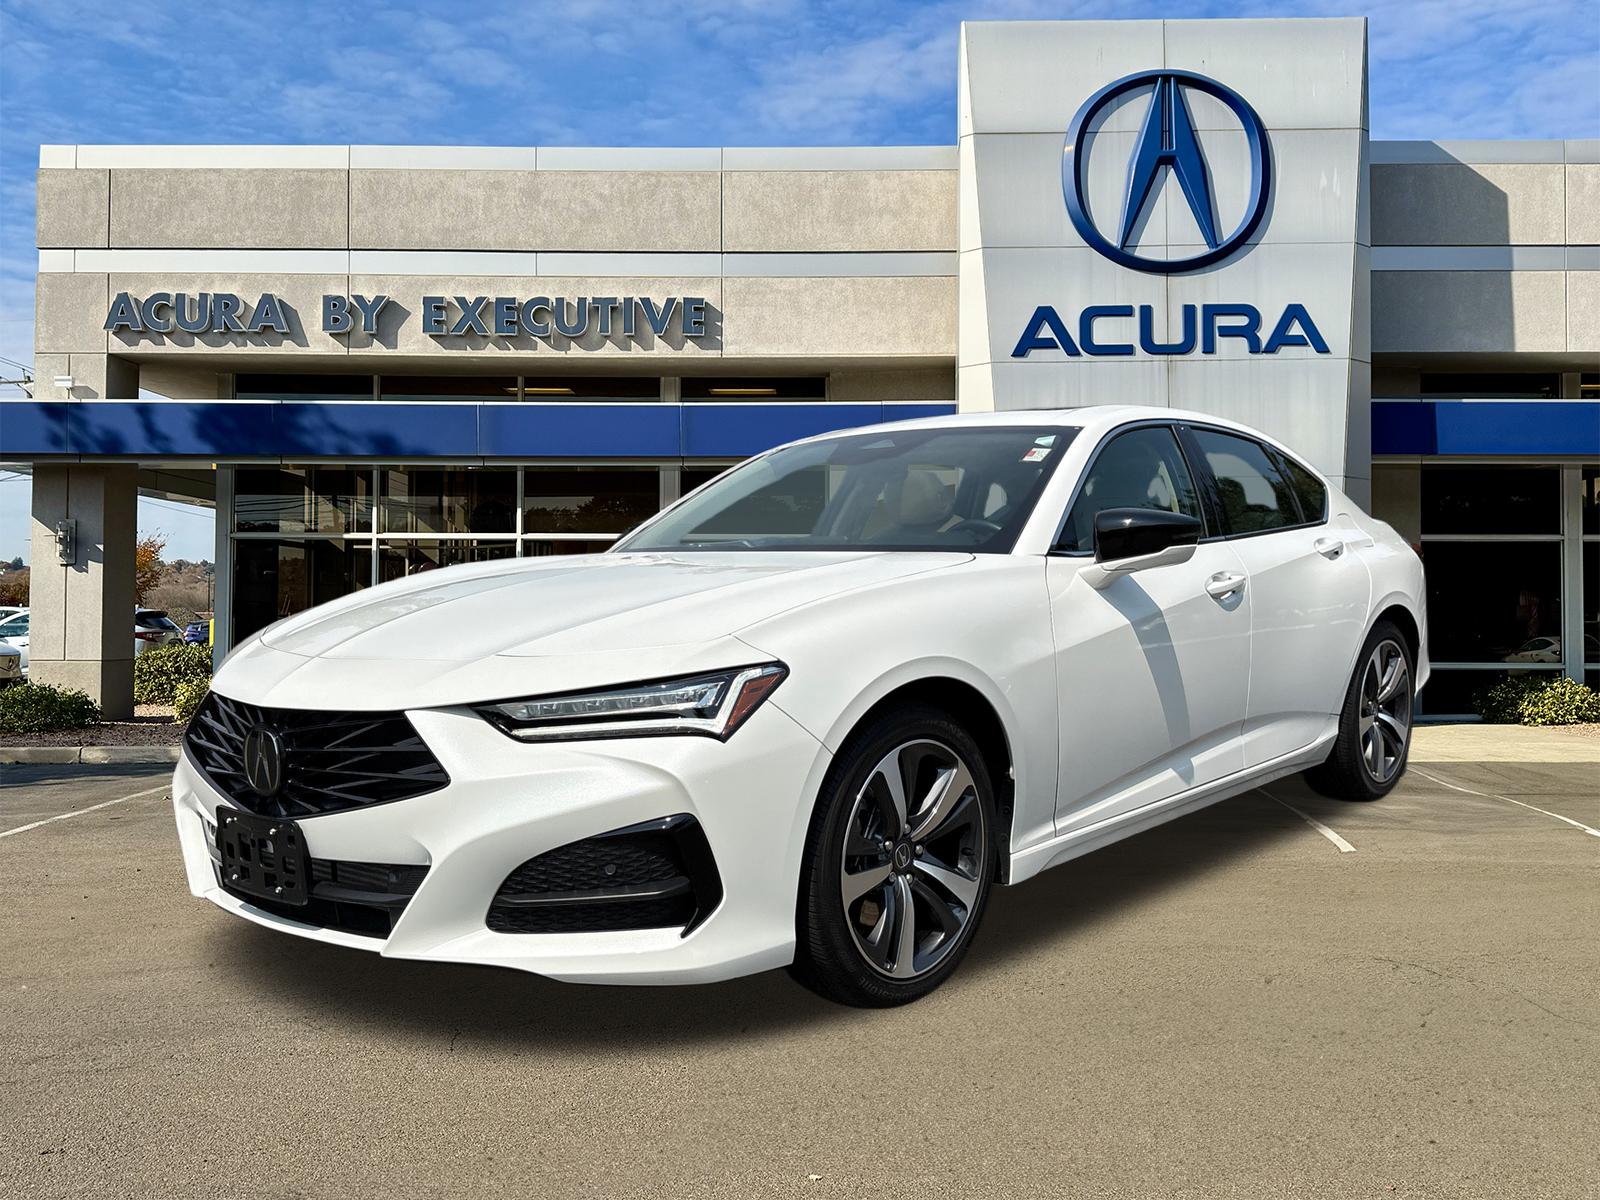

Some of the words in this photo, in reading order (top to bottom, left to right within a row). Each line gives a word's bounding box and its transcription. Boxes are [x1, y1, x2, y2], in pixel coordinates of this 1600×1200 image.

[103, 292, 290, 333] ACURA
[321, 294, 389, 333] BY
[422, 296, 706, 337] EXECUTIVE
[1010, 303, 1332, 357] ACURA
